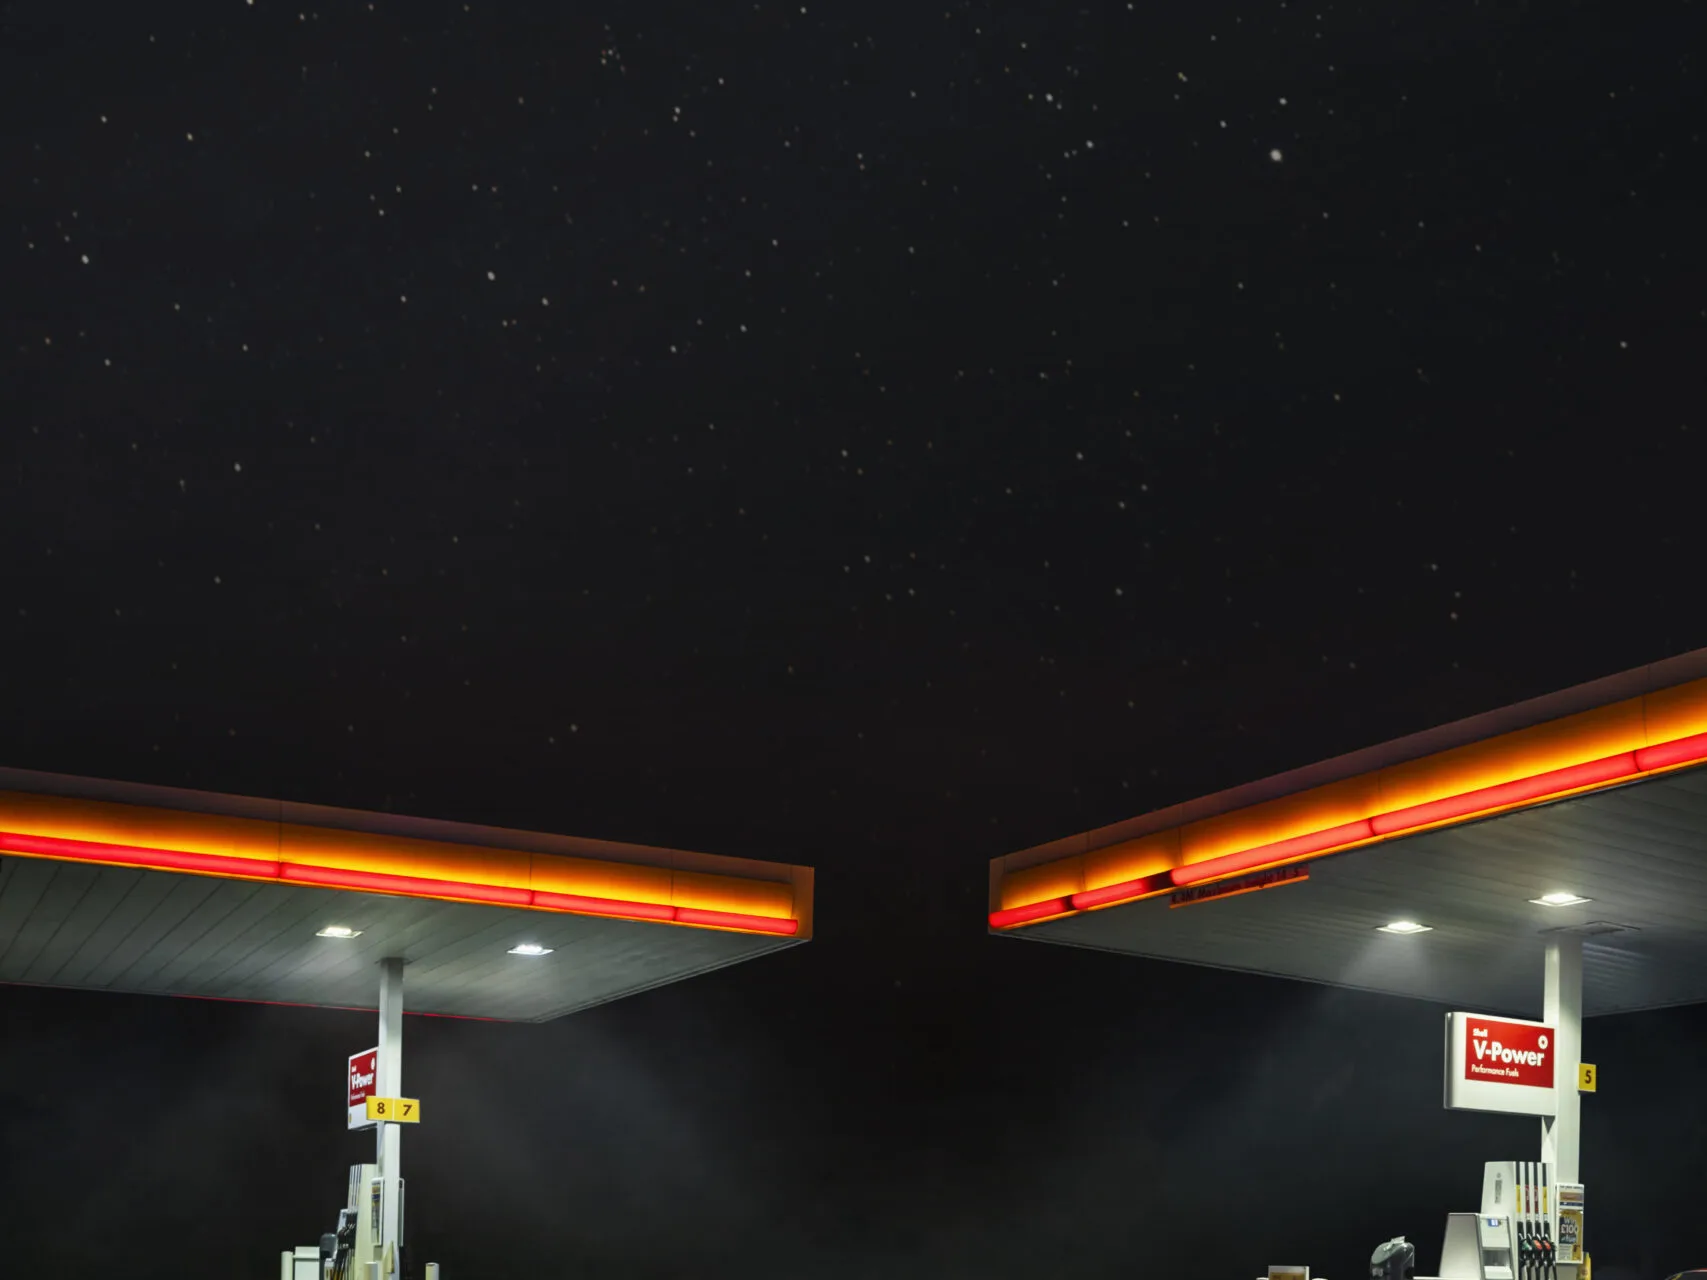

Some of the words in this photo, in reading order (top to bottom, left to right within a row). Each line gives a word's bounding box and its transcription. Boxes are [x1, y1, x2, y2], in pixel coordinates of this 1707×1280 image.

[1472, 1027, 1488, 1038] Shell
[1472, 1039, 1545, 1067] V-Power
[1471, 1063, 1505, 1076] Performance
[1505, 1067, 1519, 1078] Fuels
[1584, 1070, 1592, 1084] 5
[377, 1102, 385, 1114] 8
[403, 1104, 413, 1116] 7
